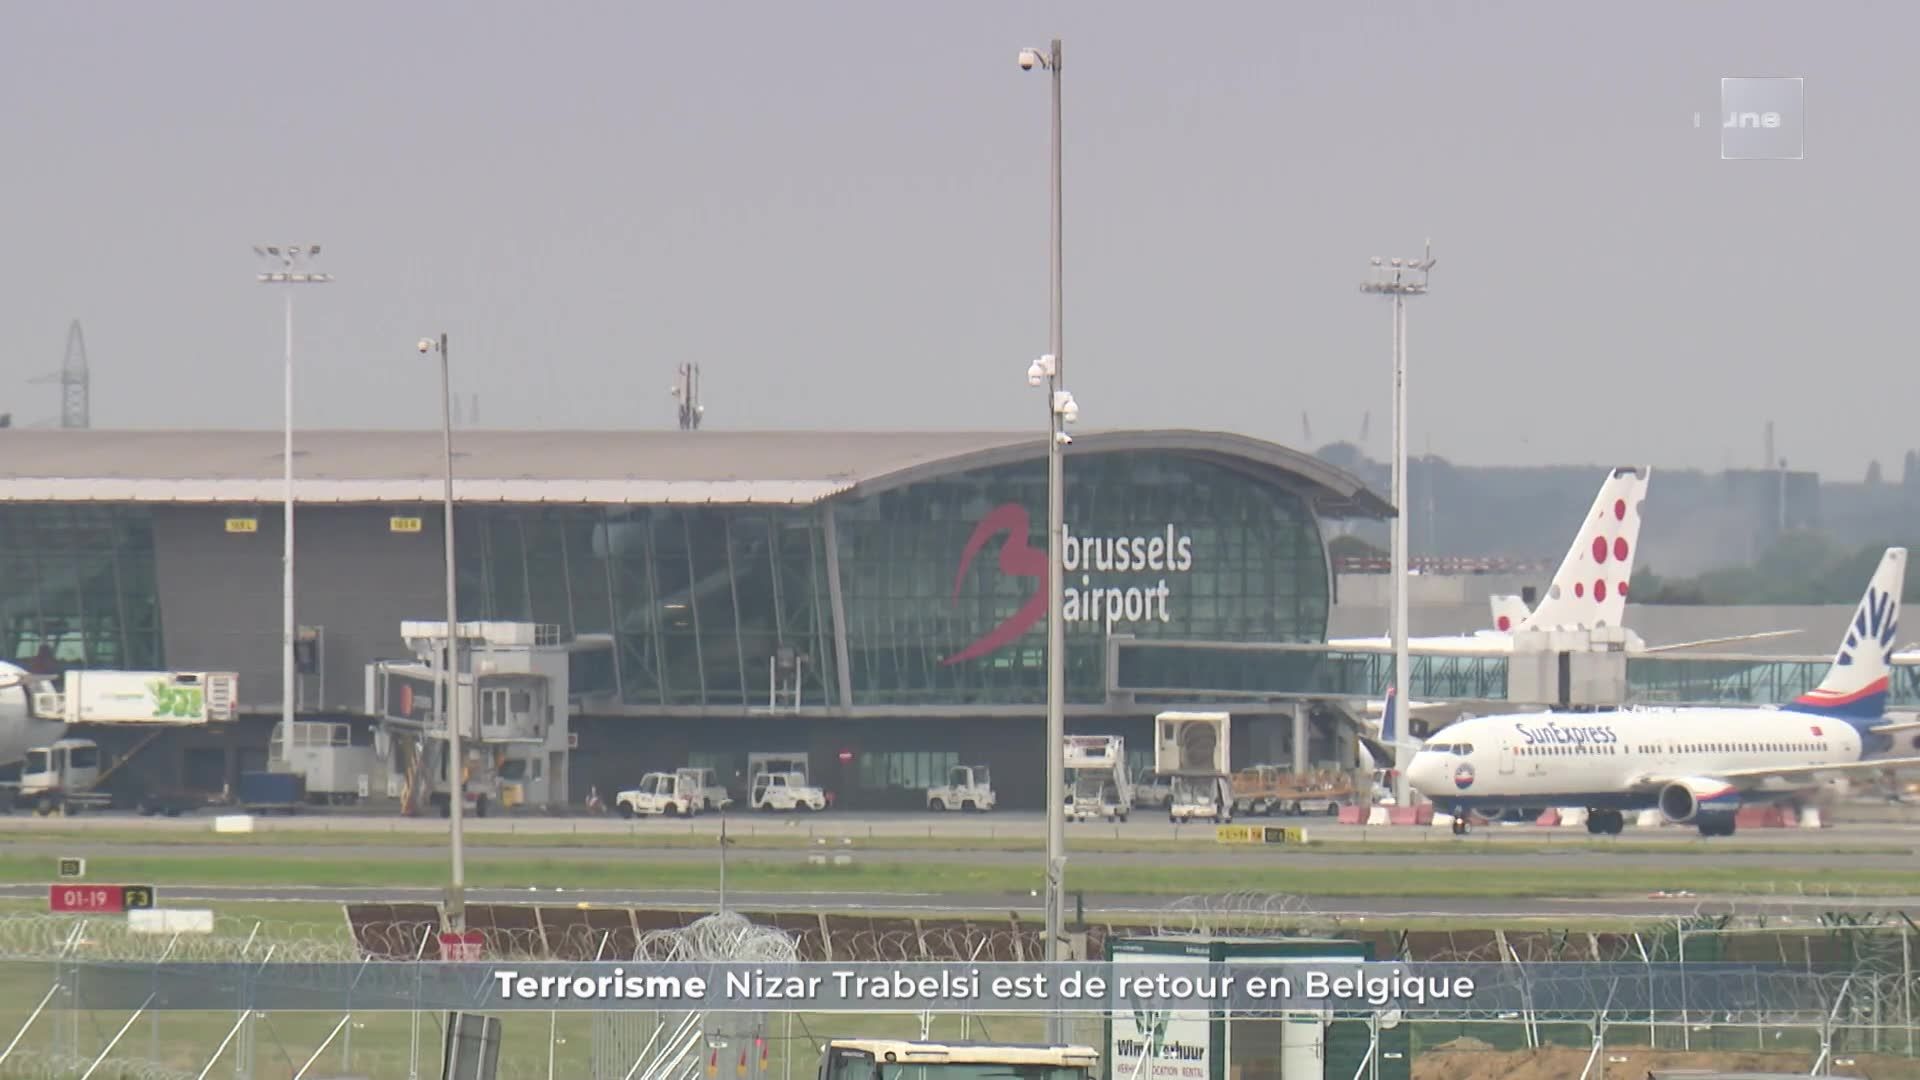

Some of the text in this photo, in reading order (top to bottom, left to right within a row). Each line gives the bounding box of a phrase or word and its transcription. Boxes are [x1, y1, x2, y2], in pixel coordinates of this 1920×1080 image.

[1062, 523, 1192, 571] brussels
[1062, 574, 1170, 634] airport
[1515, 721, 1618, 750] SunExpress
[63, 890, 108, 907] 01-19
